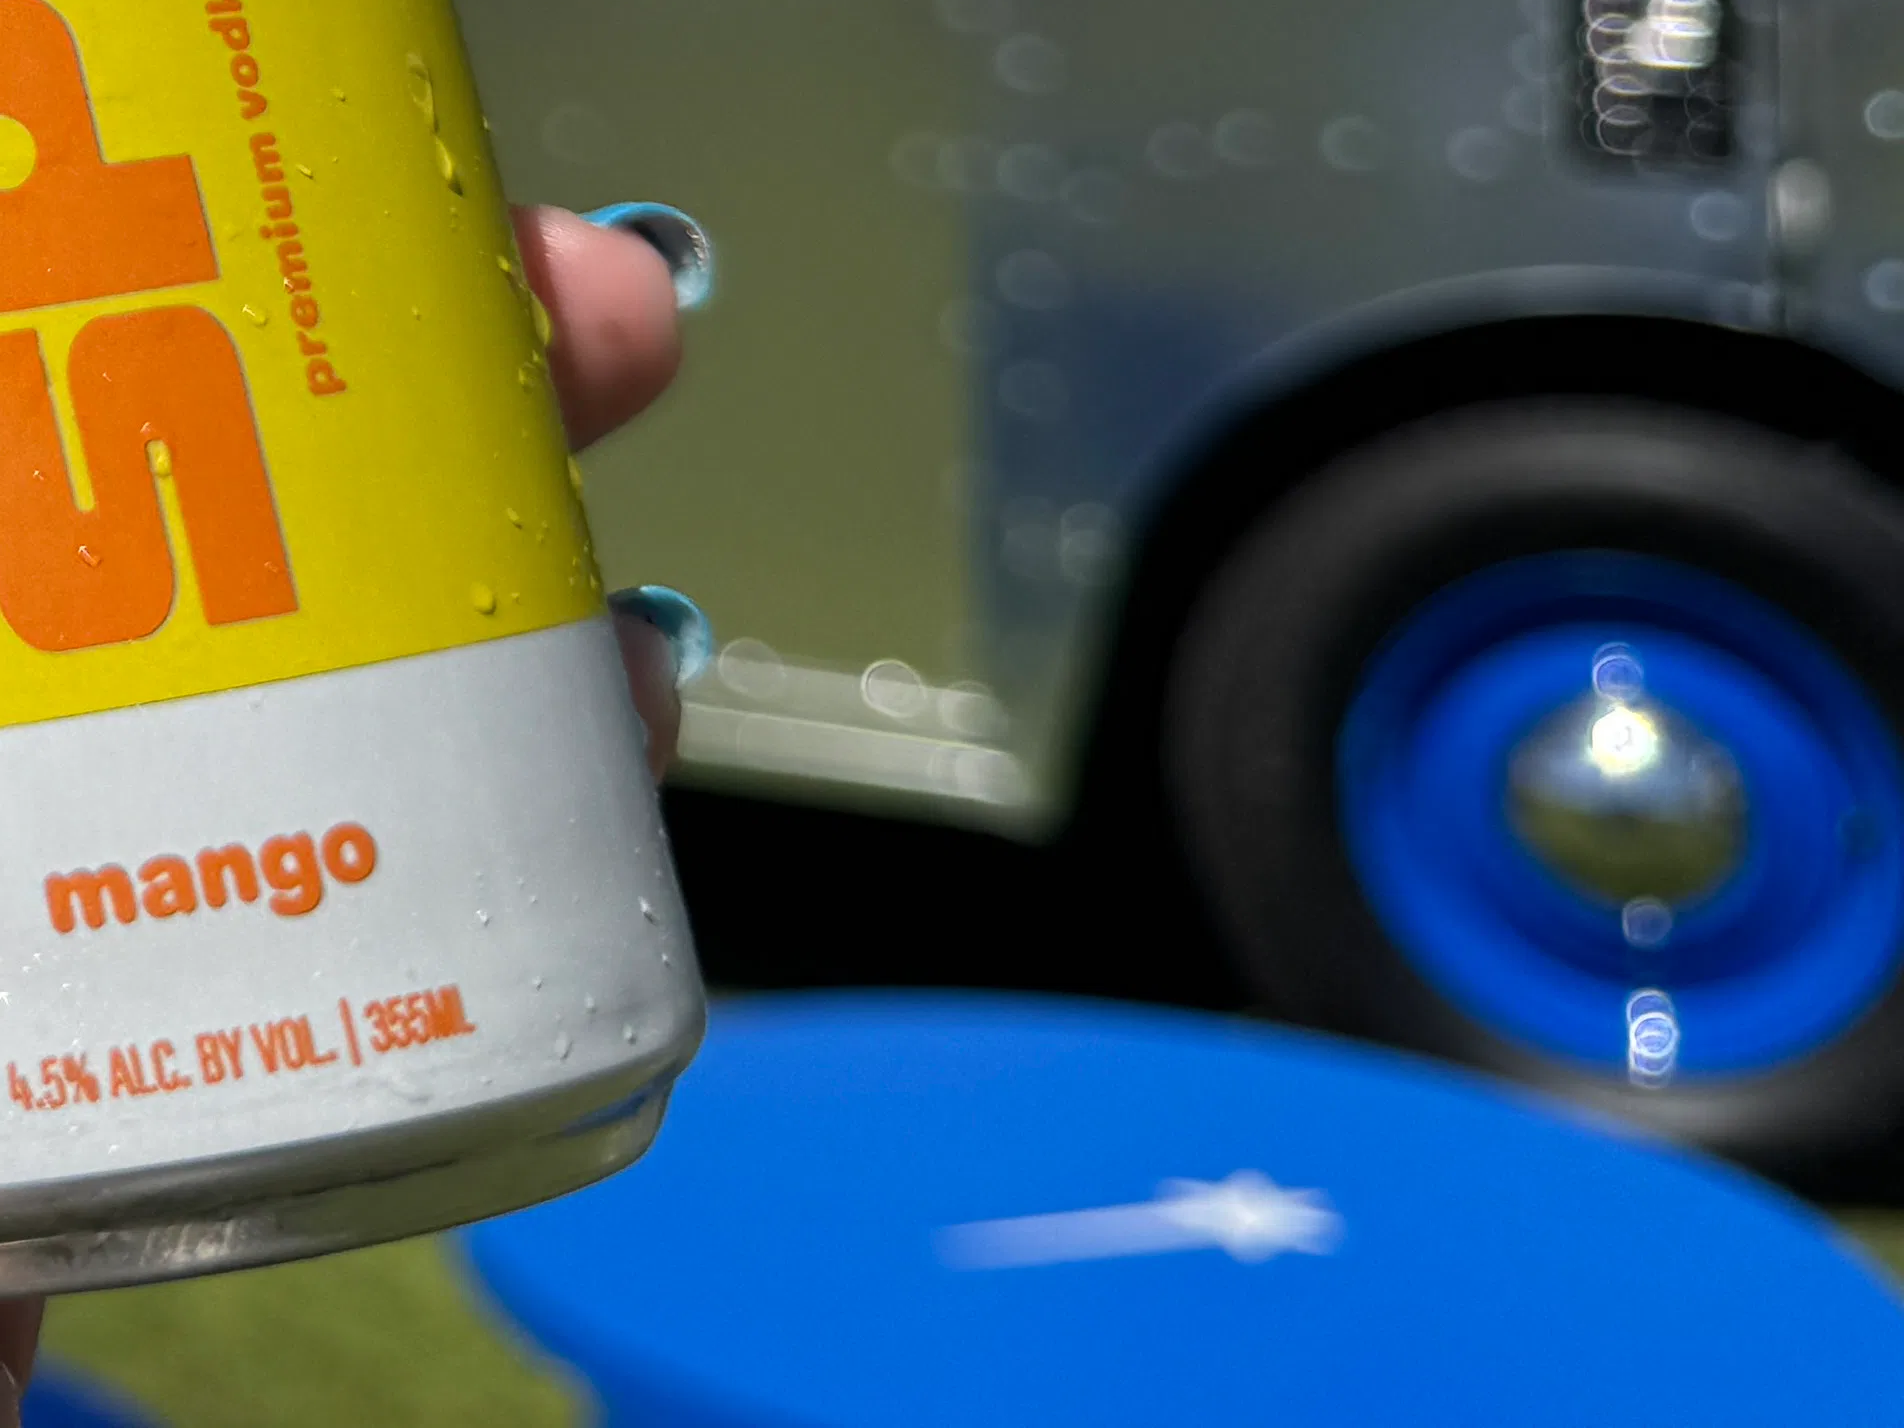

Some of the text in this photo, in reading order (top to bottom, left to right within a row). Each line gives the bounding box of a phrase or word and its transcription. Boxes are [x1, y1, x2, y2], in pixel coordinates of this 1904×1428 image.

[249, 132, 348, 398] premium
[43, 822, 377, 935] mango
[6, 983, 476, 1112] 4.5% ALC. BY VOL. 355ML
